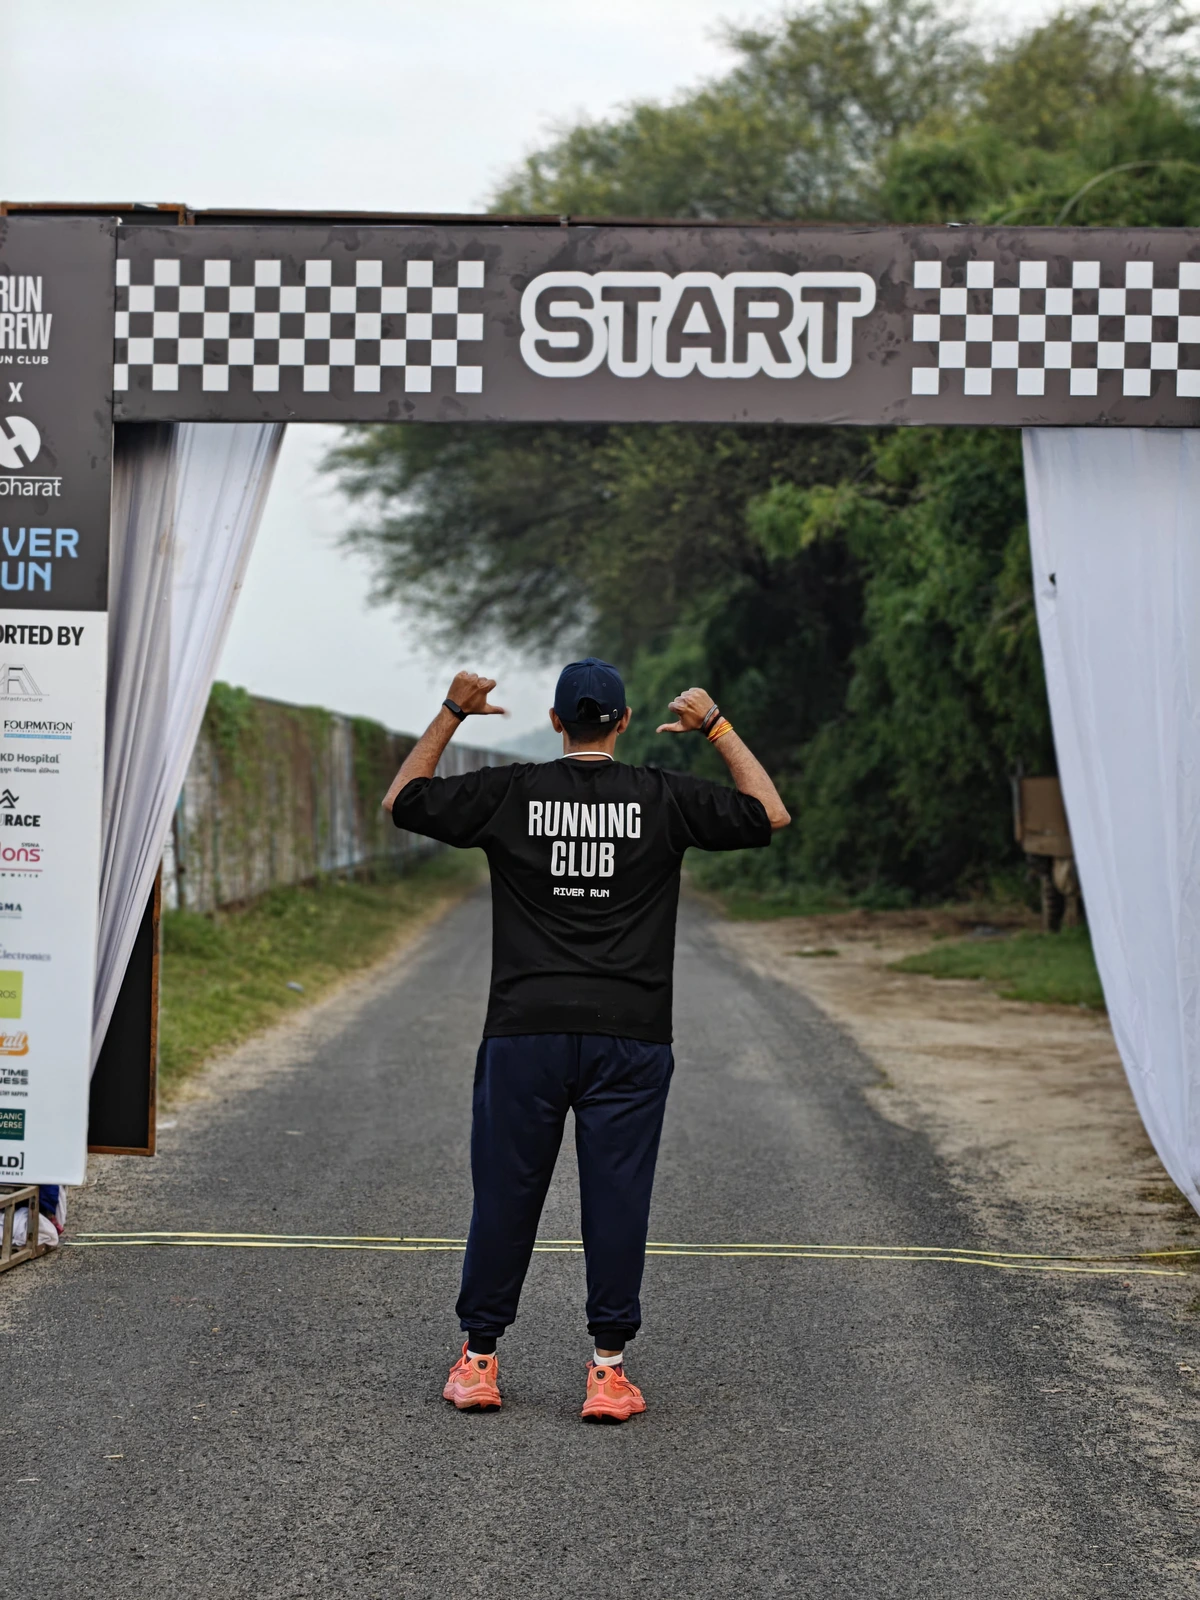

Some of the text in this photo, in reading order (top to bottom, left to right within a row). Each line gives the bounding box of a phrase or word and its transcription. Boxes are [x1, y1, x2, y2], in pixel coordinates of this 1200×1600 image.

[0, 276, 42, 312] RUN
[520, 271, 877, 379] START
[17, 355, 49, 364] CLUB
[8, 382, 23, 402] X
[2, 527, 79, 558] VER
[1, 561, 52, 591] UN
[57, 626, 84, 646] BY
[0, 753, 60, 765] KD Hospital
[528, 801, 641, 838] RUNNING
[551, 841, 615, 877] CLUB
[553, 887, 610, 897] RIVER RUN
